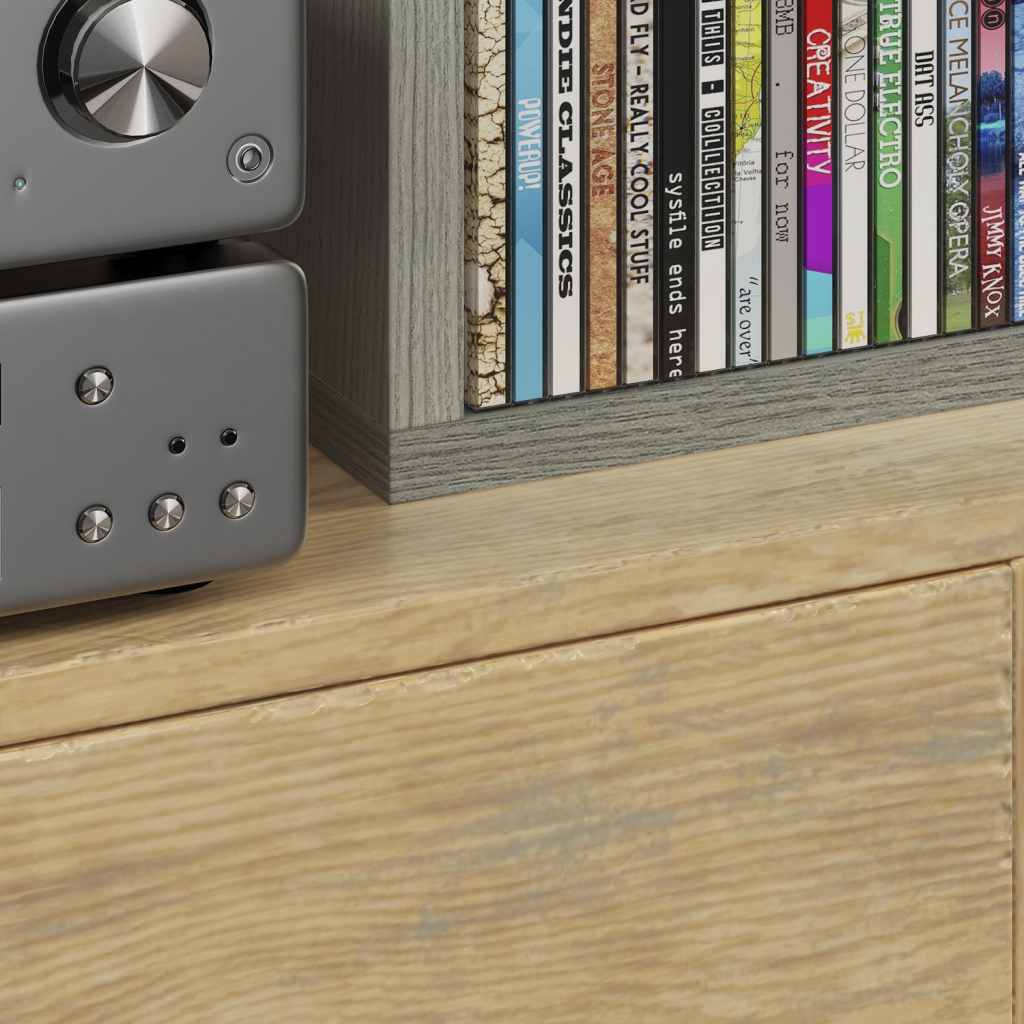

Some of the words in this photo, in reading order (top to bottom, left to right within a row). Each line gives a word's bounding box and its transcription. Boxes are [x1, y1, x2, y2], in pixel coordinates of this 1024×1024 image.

[630, 23, 649, 56] FLY
[702, 8, 724, 67] THIS
[844, 36, 866, 84] ONE
[914, 50, 935, 88] DAT
[592, 63, 615, 138] STONE
[630, 83, 649, 154] REALLY
[807, 28, 832, 174] CREATIVITY
[879, 71, 902, 189] ELECTRO
[914, 93, 935, 128] ASS
[948, 38, 970, 196] MELANCHOLY
[518, 97, 541, 191] POWERUP!
[844, 89, 866, 173] DOLLAR
[592, 148, 615, 198] AGE
[630, 163, 649, 222] COOL
[702, 106, 724, 252] COLLECTION
[775, 150, 794, 189] for
[558, 101, 573, 299] CLASSICS
[665, 172, 687, 250] sysfile
[775, 202, 789, 243] now
[630, 229, 649, 285] STUFF
[948, 201, 969, 279] OPERA
[981, 205, 1006, 258] JIMMY
[669, 263, 687, 315] ends
[981, 263, 1006, 319] KNOX
[669, 328, 687, 378] here
